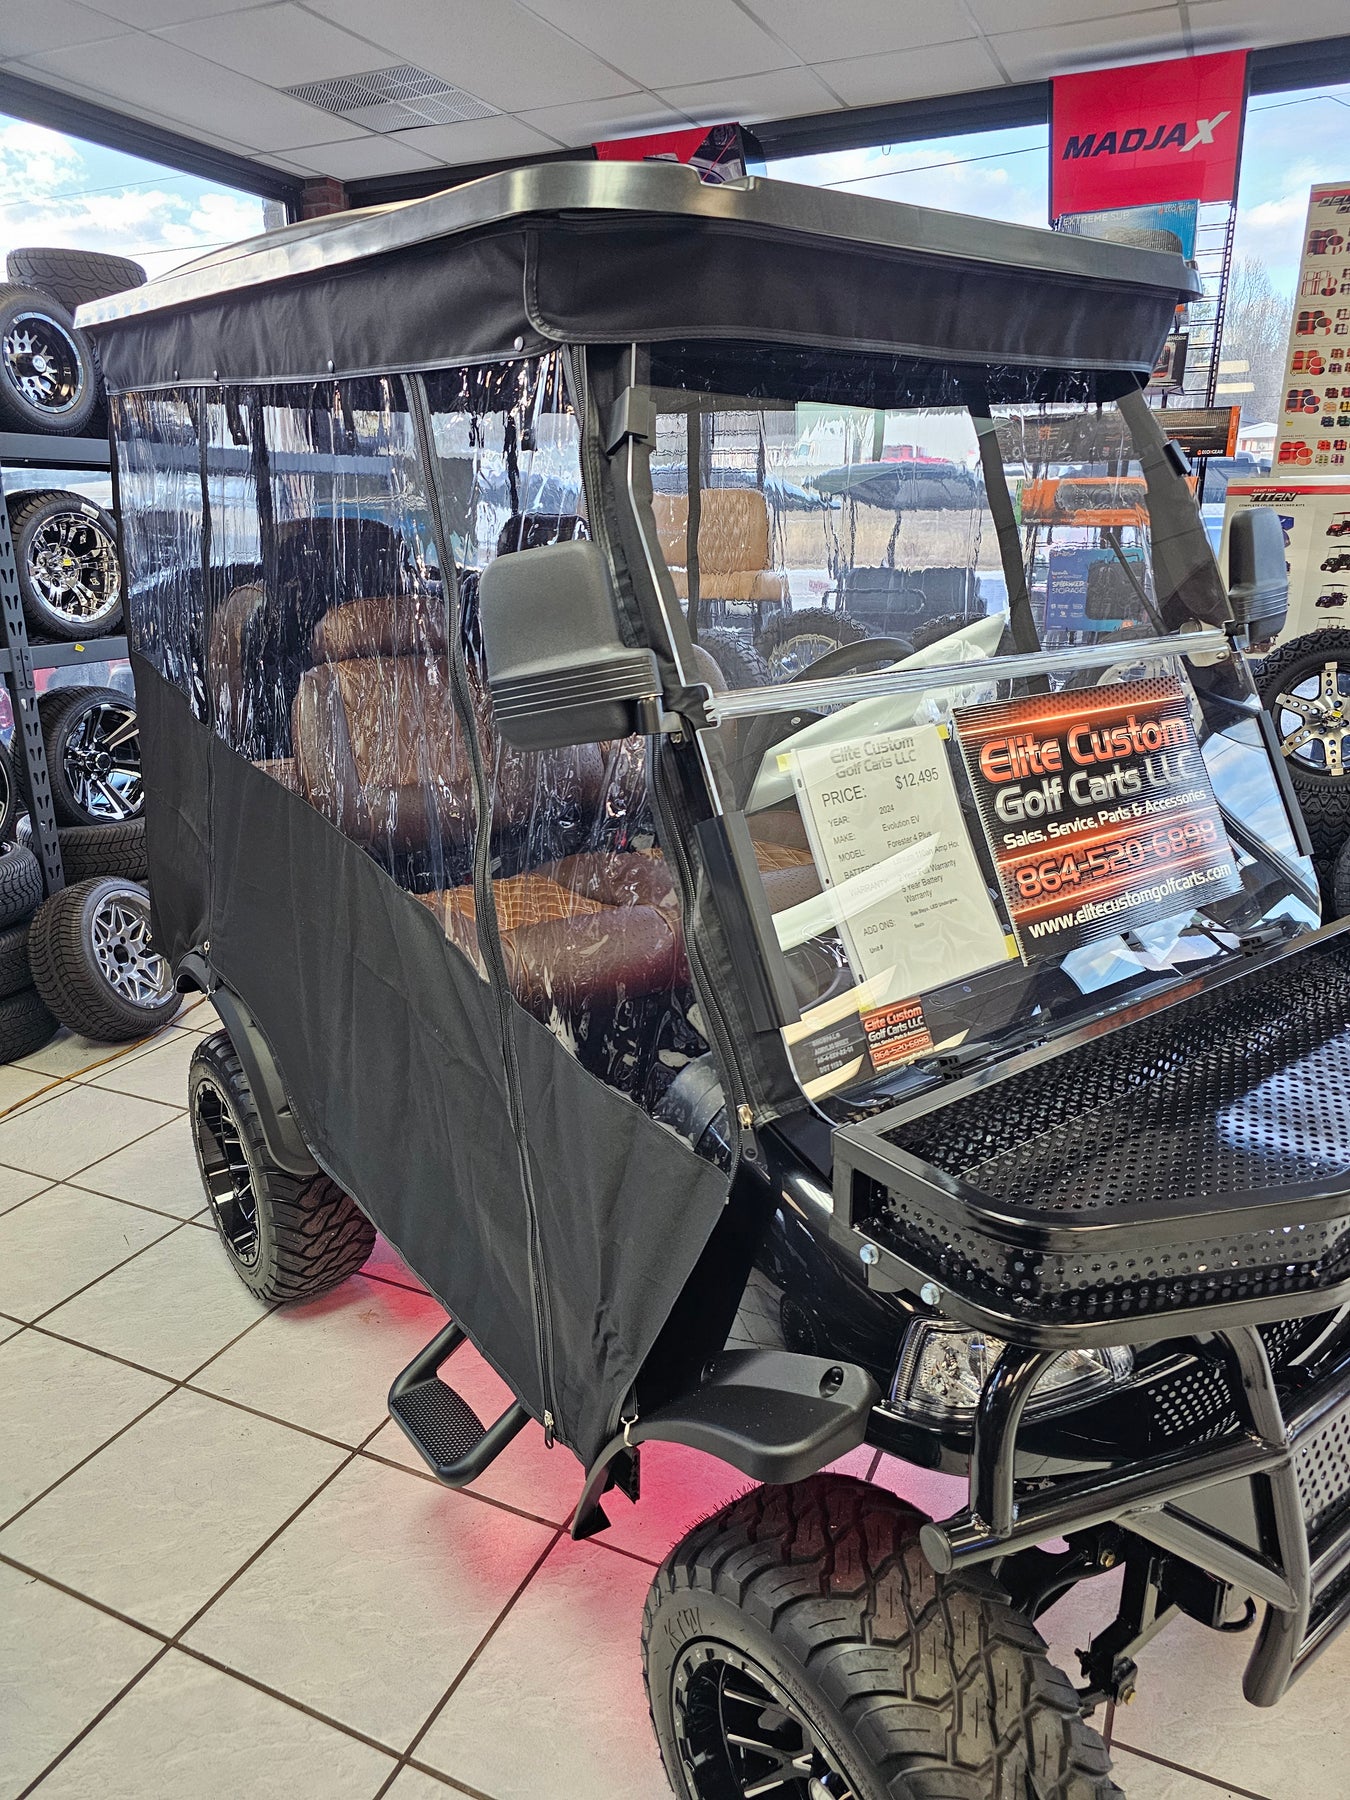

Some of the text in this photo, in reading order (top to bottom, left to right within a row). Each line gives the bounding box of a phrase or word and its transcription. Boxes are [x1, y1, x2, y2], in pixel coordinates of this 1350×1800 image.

[1062, 110, 1232, 161] MADJAX
[1063, 211, 1130, 227] EXTREME SUB
[1250, 492, 1297, 502] TITAN
[830, 736, 915, 765] Elite Custom
[978, 715, 1188, 784] Elite Custom
[835, 749, 917, 779] Golf Carts LLC
[821, 767, 939, 808] PRICE: $12,495
[993, 750, 1197, 825] Golf Carts LLC
[828, 804, 895, 828] YEAR: 2024
[1003, 788, 1207, 851] Sales, Service, Parts & Accessories
[833, 815, 921, 846] MAKE: Evolution EV
[886, 831, 933, 849] Forester 4 Plus
[838, 849, 866, 862] MODEL:
[935, 844, 947, 853] Amp
[1014, 819, 1219, 899] 864-520-6898
[930, 859, 957, 872] Warranty
[907, 881, 921, 891] Year
[922, 875, 944, 887] Battery
[904, 889, 933, 904] Warranty
[1028, 863, 1233, 940] www.elitecustomgolfcarts.com
[863, 919, 896, 937] ADD ONS:
[869, 946, 880, 955] Unit
[864, 1006, 922, 1032] Elite Custom
[868, 1015, 924, 1042] Golf Carts LLC
